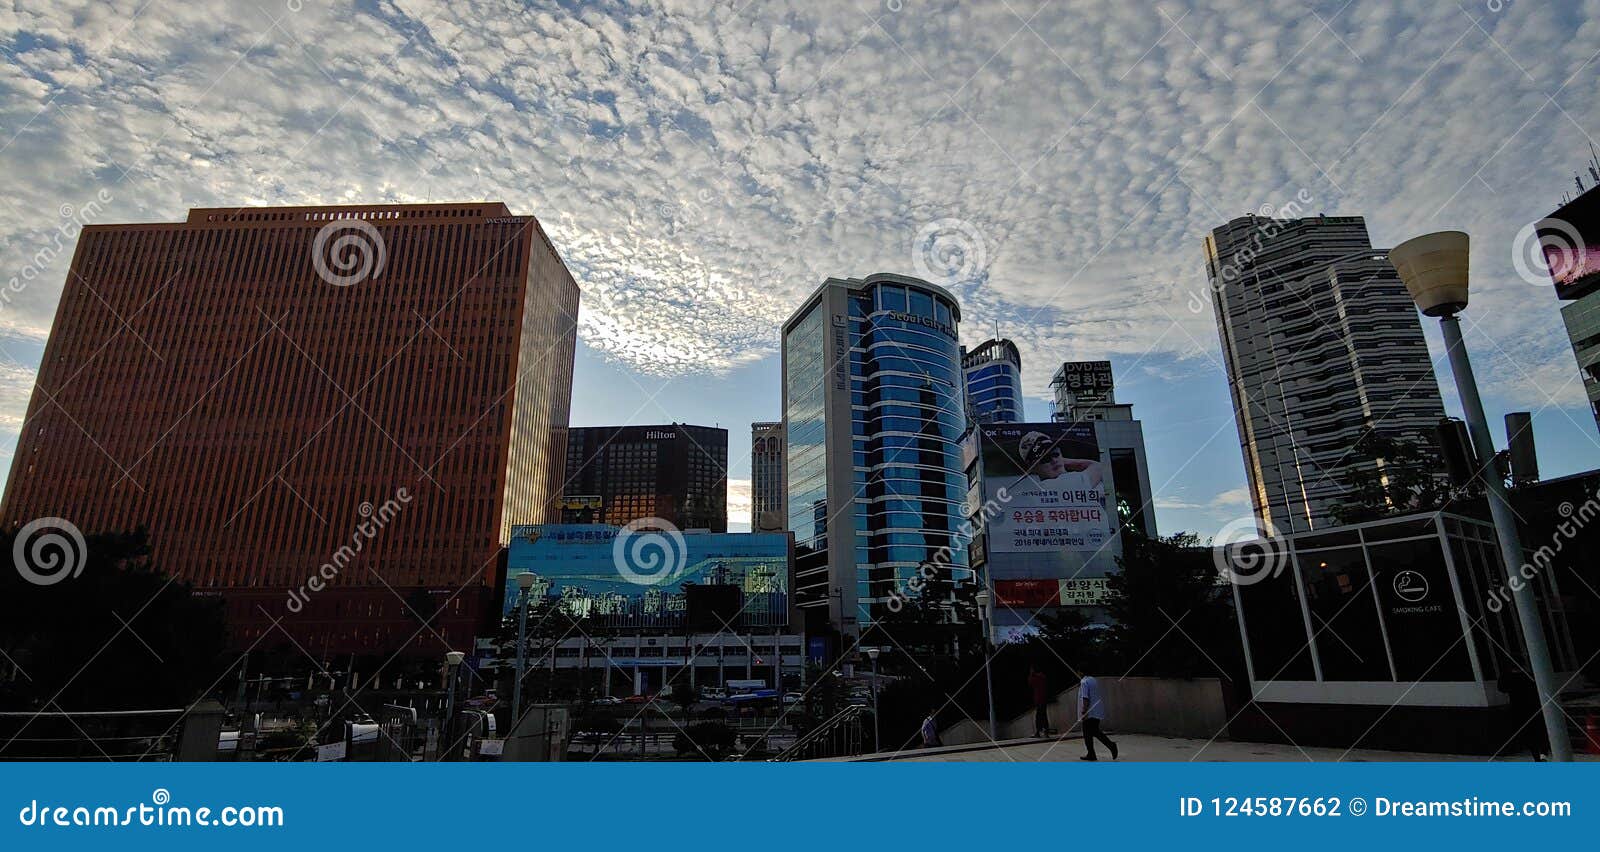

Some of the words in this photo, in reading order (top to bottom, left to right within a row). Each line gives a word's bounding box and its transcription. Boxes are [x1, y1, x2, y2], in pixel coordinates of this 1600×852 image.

[889, 311, 920, 323] Seoul
[922, 316, 943, 331] City
[1066, 362, 1093, 373] DVD
[1067, 371, 1113, 389] 영화관
[646, 431, 676, 439] Hilton
[1062, 490, 1100, 503] 이태희
[1013, 510, 1045, 523] 우승을
[1048, 509, 1101, 523] 축하합니다
[1425, 605, 1442, 613] CAFE
